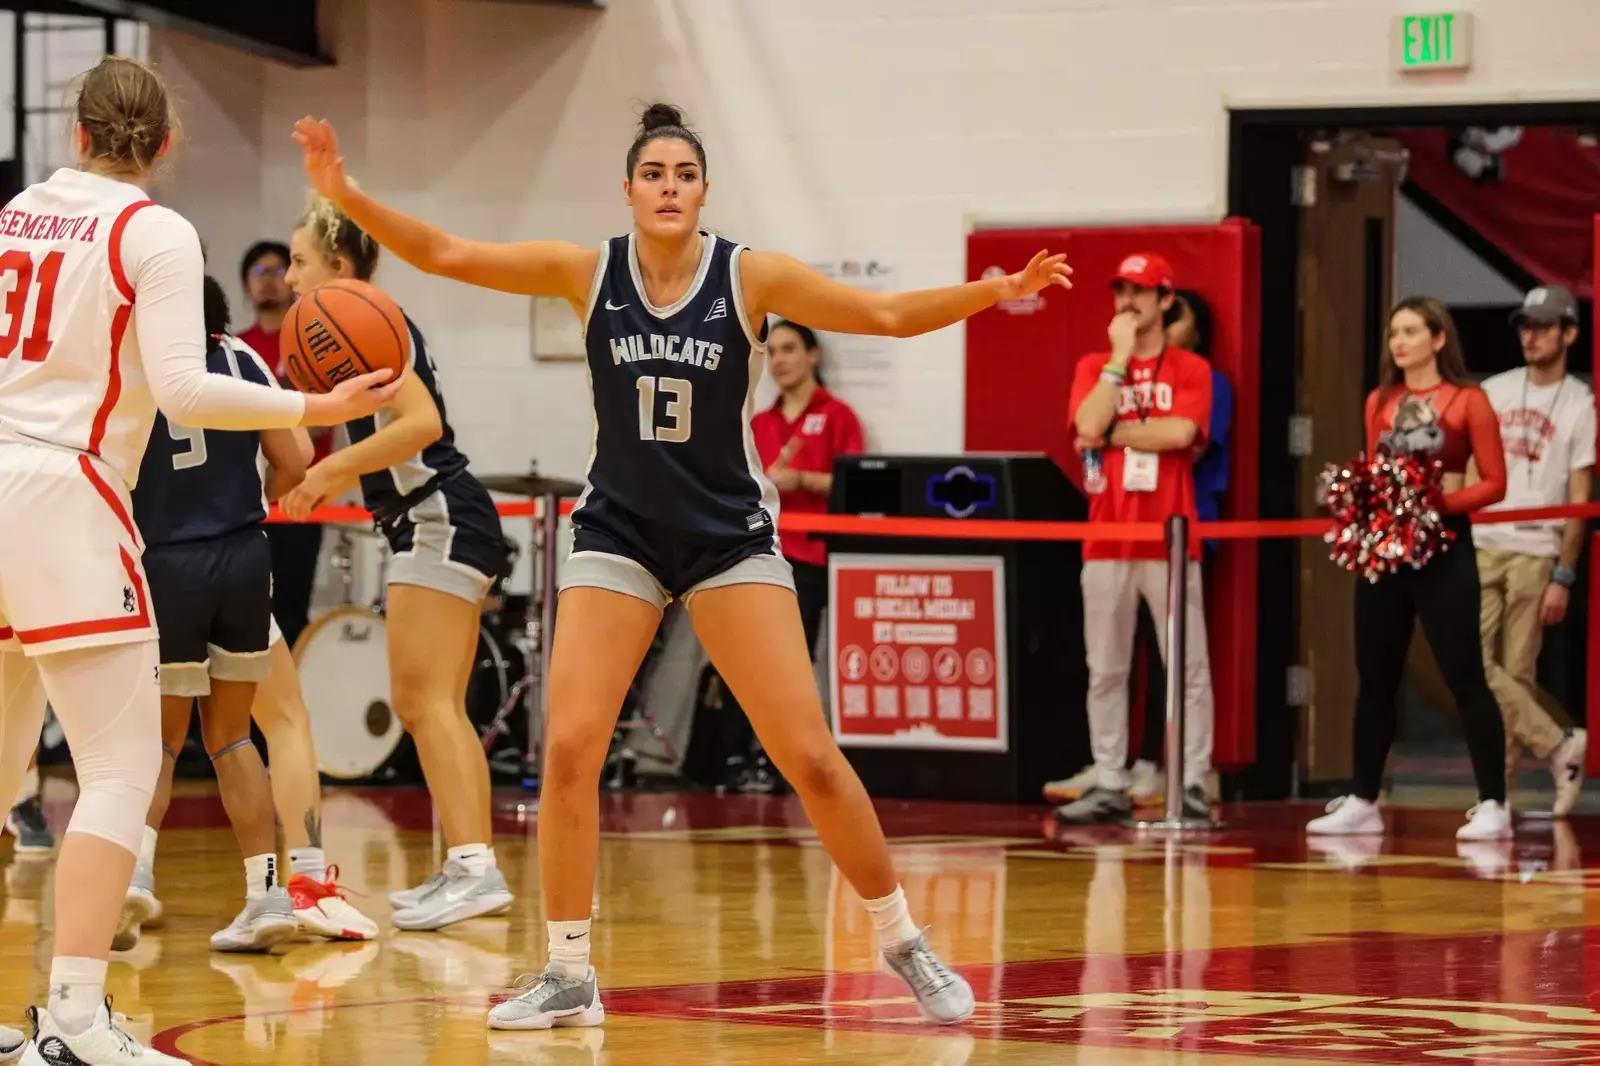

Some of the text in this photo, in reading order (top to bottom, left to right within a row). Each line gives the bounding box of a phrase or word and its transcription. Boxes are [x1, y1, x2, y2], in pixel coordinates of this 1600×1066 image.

[1403, 14, 1455, 64] EXIT
[0, 209, 100, 243] SEMENOVA
[0, 249, 66, 362] 31
[304, 318, 342, 363] THE
[609, 333, 724, 371] WILDCATS
[636, 375, 692, 443] 13
